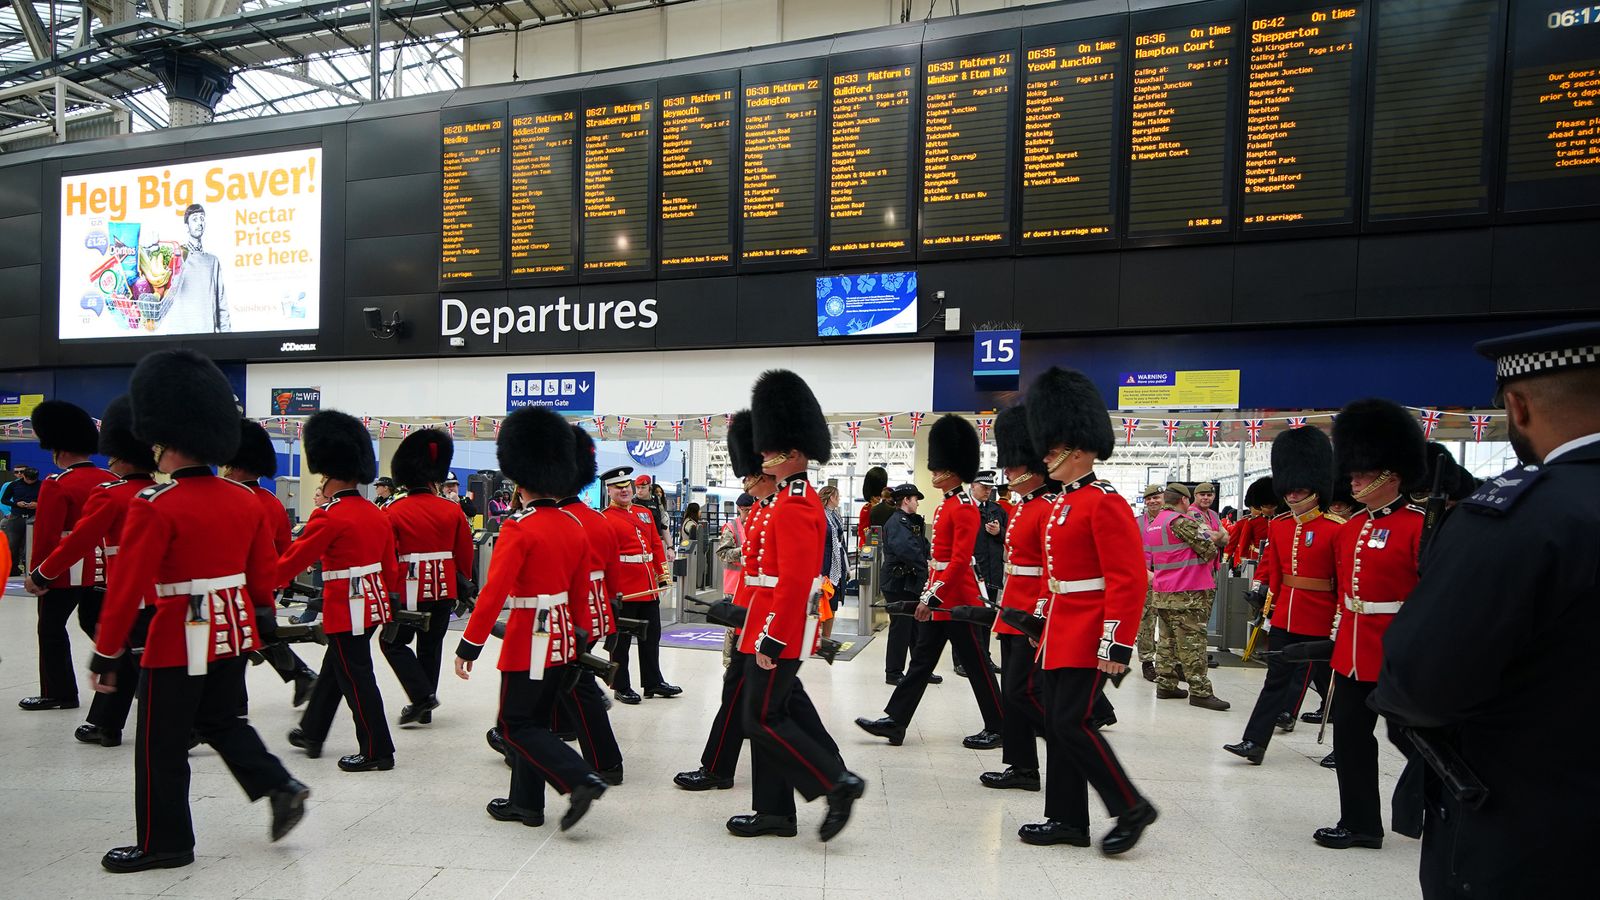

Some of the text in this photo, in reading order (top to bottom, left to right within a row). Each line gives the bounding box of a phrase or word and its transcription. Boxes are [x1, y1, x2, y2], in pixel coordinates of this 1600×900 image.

[1252, 7, 1356, 30] 06:42 On time
[1548, 6, 1600, 29] 06:17
[1135, 24, 1231, 46] 06:36 On time
[1252, 26, 1319, 45] Shepperton
[1027, 41, 1116, 60] 06:35 On time
[1135, 40, 1214, 59] Hampton Court
[1264, 41, 1304, 52] Kingston
[1251, 53, 1275, 63] Calling
[1309, 46, 1327, 56] Page
[927, 54, 1010, 73] 06:33 Platform 21
[1027, 55, 1102, 72] Yeovil Junction
[1250, 62, 1284, 71] Vauxhall
[1135, 68, 1158, 77] Calling
[1188, 62, 1206, 71] Page
[1250, 66, 1312, 81] Clapham Junction
[927, 74, 958, 85] Windsor
[968, 68, 990, 80] Eton
[992, 67, 1006, 76] Riv
[1548, 69, 1595, 81] Our doors
[1134, 76, 1164, 85] Vauxhall
[1249, 78, 1285, 88] Wimbledon
[1134, 81, 1192, 94] Clapham Junction
[1249, 89, 1276, 98] Raynes
[1539, 93, 1563, 103] prior
[1026, 96, 1064, 106] Basingstoke
[1263, 96, 1290, 104] Malden
[1572, 99, 1594, 108] time.
[1133, 110, 1157, 119] Raynes
[1248, 105, 1280, 115] Norbiton
[1026, 112, 1060, 122] Whitchurch
[1146, 117, 1172, 126] Malden
[1248, 115, 1280, 124] Kingston
[1248, 124, 1279, 133] Hampton
[1556, 119, 1586, 129] Please
[1132, 126, 1169, 136] Berrylands
[1248, 131, 1288, 141] Teddington
[1547, 128, 1595, 139] ahead and
[1025, 138, 1054, 146] Salisbury
[1132, 135, 1161, 143] Surbiton
[1025, 146, 1050, 155] Tisbury
[1132, 144, 1157, 152] Thames
[1247, 141, 1273, 150] Fulwell
[1137, 151, 1168, 160] Hampton
[1247, 150, 1277, 159] Hampton
[1556, 149, 1585, 157] trains
[1025, 161, 1065, 171] Templecombe
[1246, 159, 1278, 167] Kempton
[1024, 170, 1057, 179] Sherborne
[1246, 168, 1276, 177] Sunbury
[1245, 174, 1302, 185] Upper Halliford
[66, 156, 316, 220] Hey Big Saver!
[1251, 183, 1296, 193] Shepperton
[236, 207, 296, 226] Nectar
[235, 230, 291, 246] Prices
[110, 246, 136, 256] Doritos
[235, 246, 313, 267] are here.
[442, 296, 658, 343] Departures
[280, 342, 316, 351] JCDecaux
[980, 339, 1014, 362] 15
[303, 392, 319, 400] WiFi
